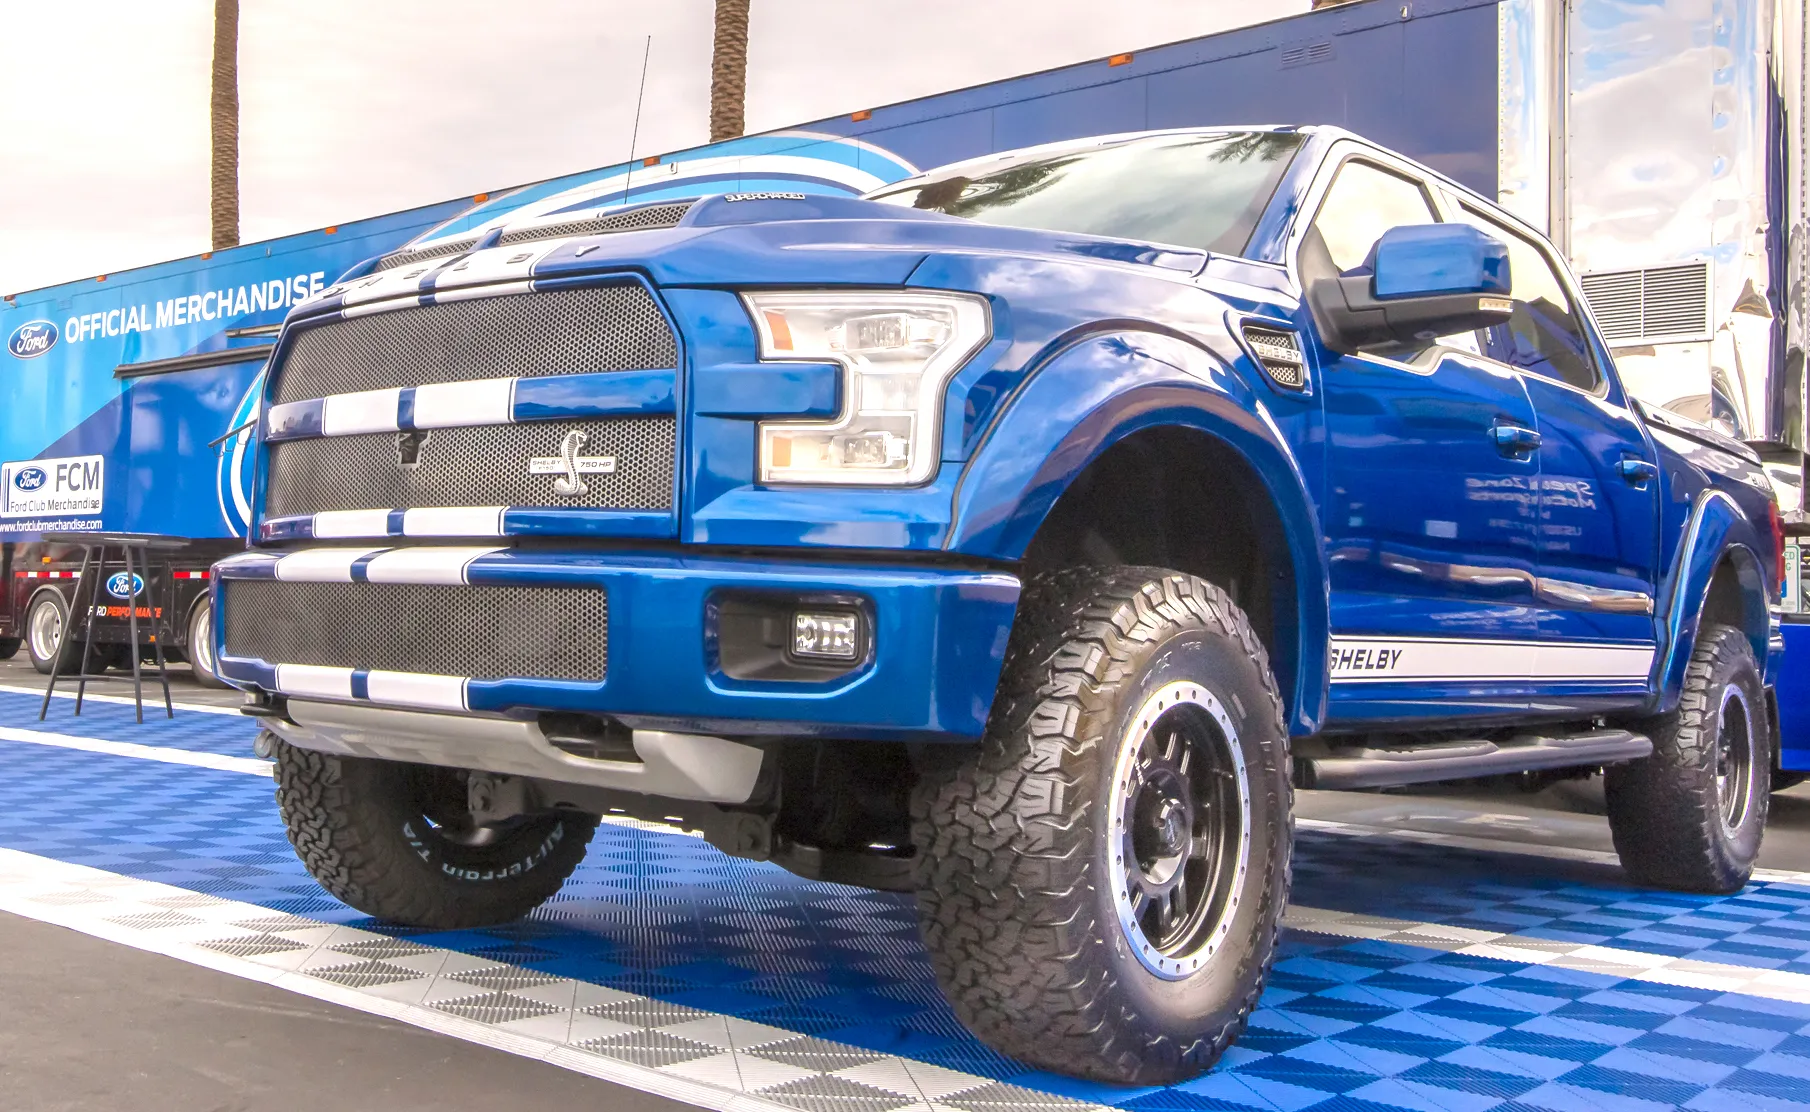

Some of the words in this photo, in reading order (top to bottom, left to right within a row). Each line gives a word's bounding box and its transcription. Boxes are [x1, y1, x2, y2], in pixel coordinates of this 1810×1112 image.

[725, 192, 806, 202] SUPERCHARGED
[65, 300, 151, 344] OFFICIAL
[155, 271, 325, 329] MERCHANDISE
[17, 325, 48, 352] Ford
[20, 470, 41, 488] Ford
[55, 461, 100, 492] FCM
[10, 501, 27, 512] Ford
[28, 500, 46, 512] Club
[47, 497, 100, 511] Merchandise
[88, 605, 107, 617] FRD
[106, 606, 162, 618] PERFOMANE
[1330, 648, 1403, 670] SHELBY
